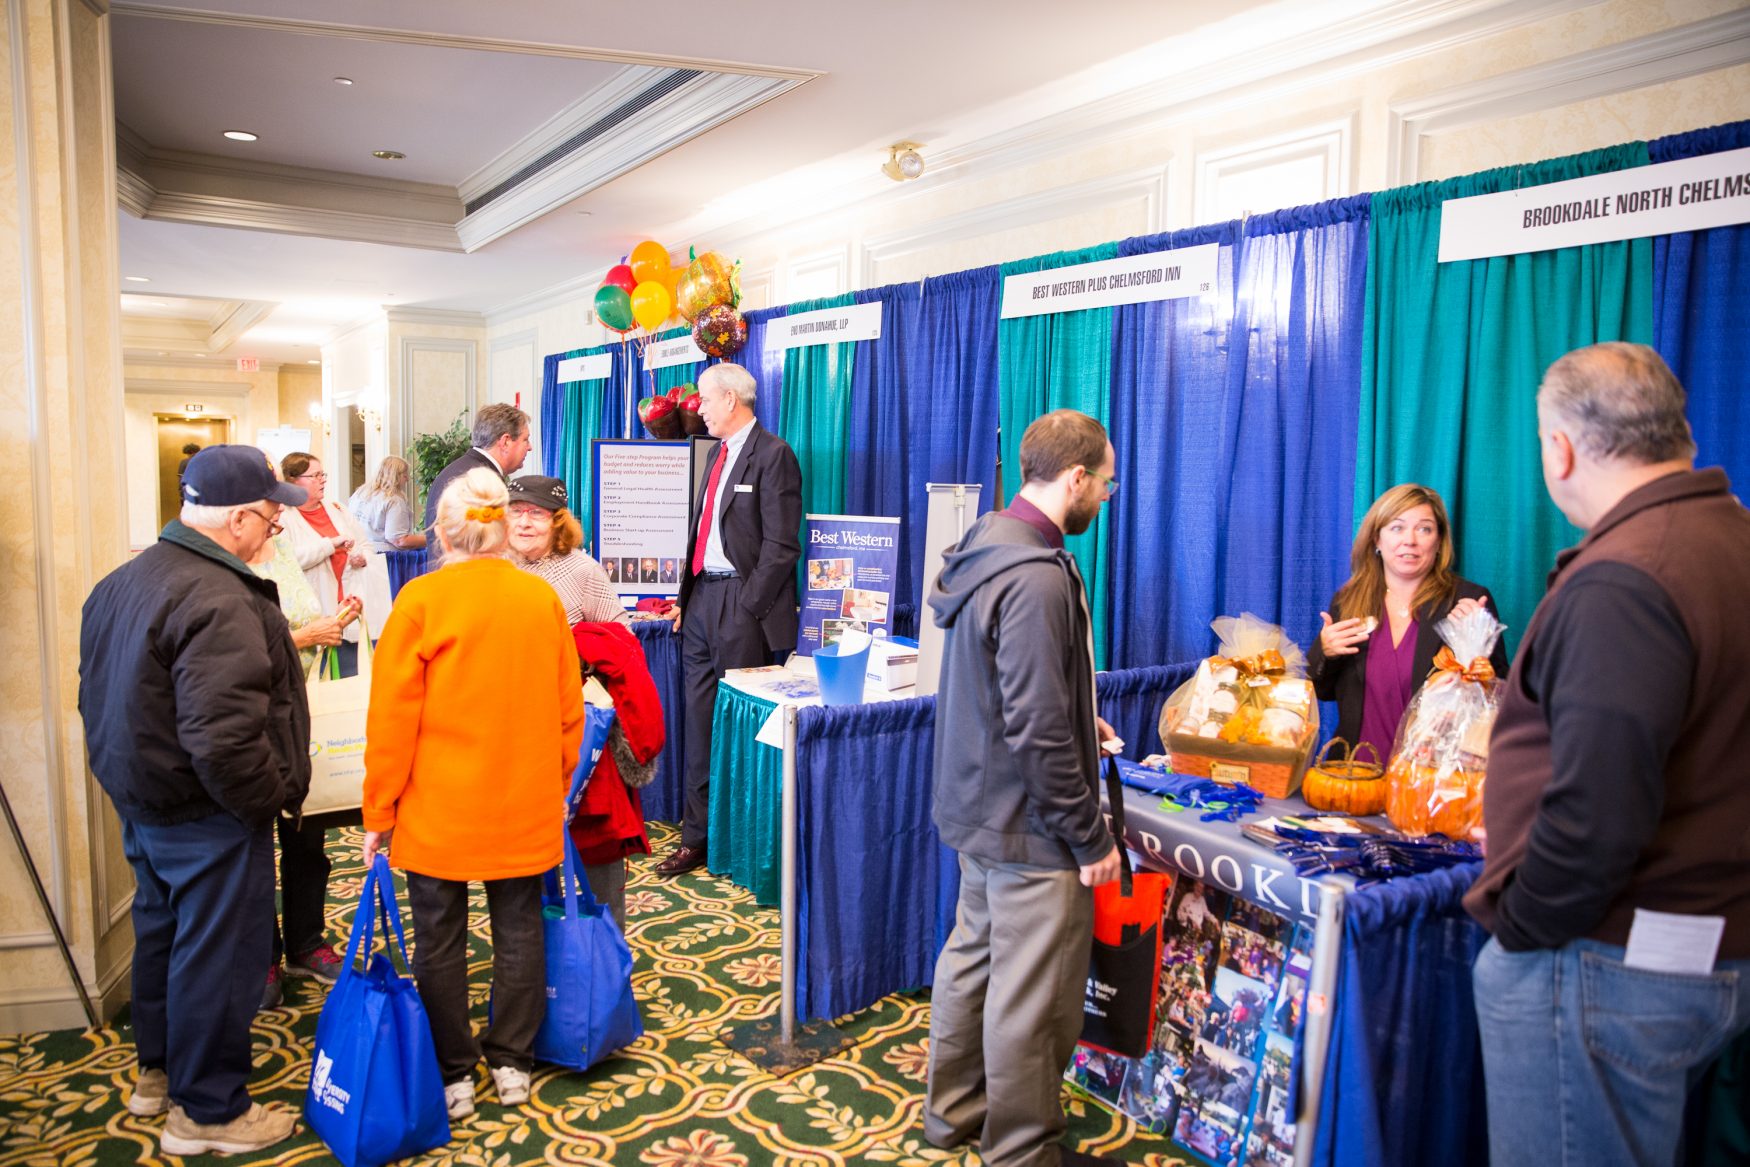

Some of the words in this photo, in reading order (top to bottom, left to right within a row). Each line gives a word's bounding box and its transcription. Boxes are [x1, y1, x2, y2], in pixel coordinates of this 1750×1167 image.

[1522, 196, 1611, 229] BROOKDALE
[1615, 186, 1673, 215] NORTH
[1032, 284, 1050, 300] BEST
[1051, 279, 1087, 298] WESTERN
[1088, 276, 1108, 292] PLUS
[1109, 268, 1162, 290] CHELMSFORD
[1164, 266, 1182, 282] INN
[798, 322, 815, 334] MARTIN
[840, 318, 849, 330] LLP
[241, 359, 256, 370] EXIT
[810, 529, 839, 544] Best
[841, 530, 894, 547] Western
[1094, 980, 1118, 997] Valley
